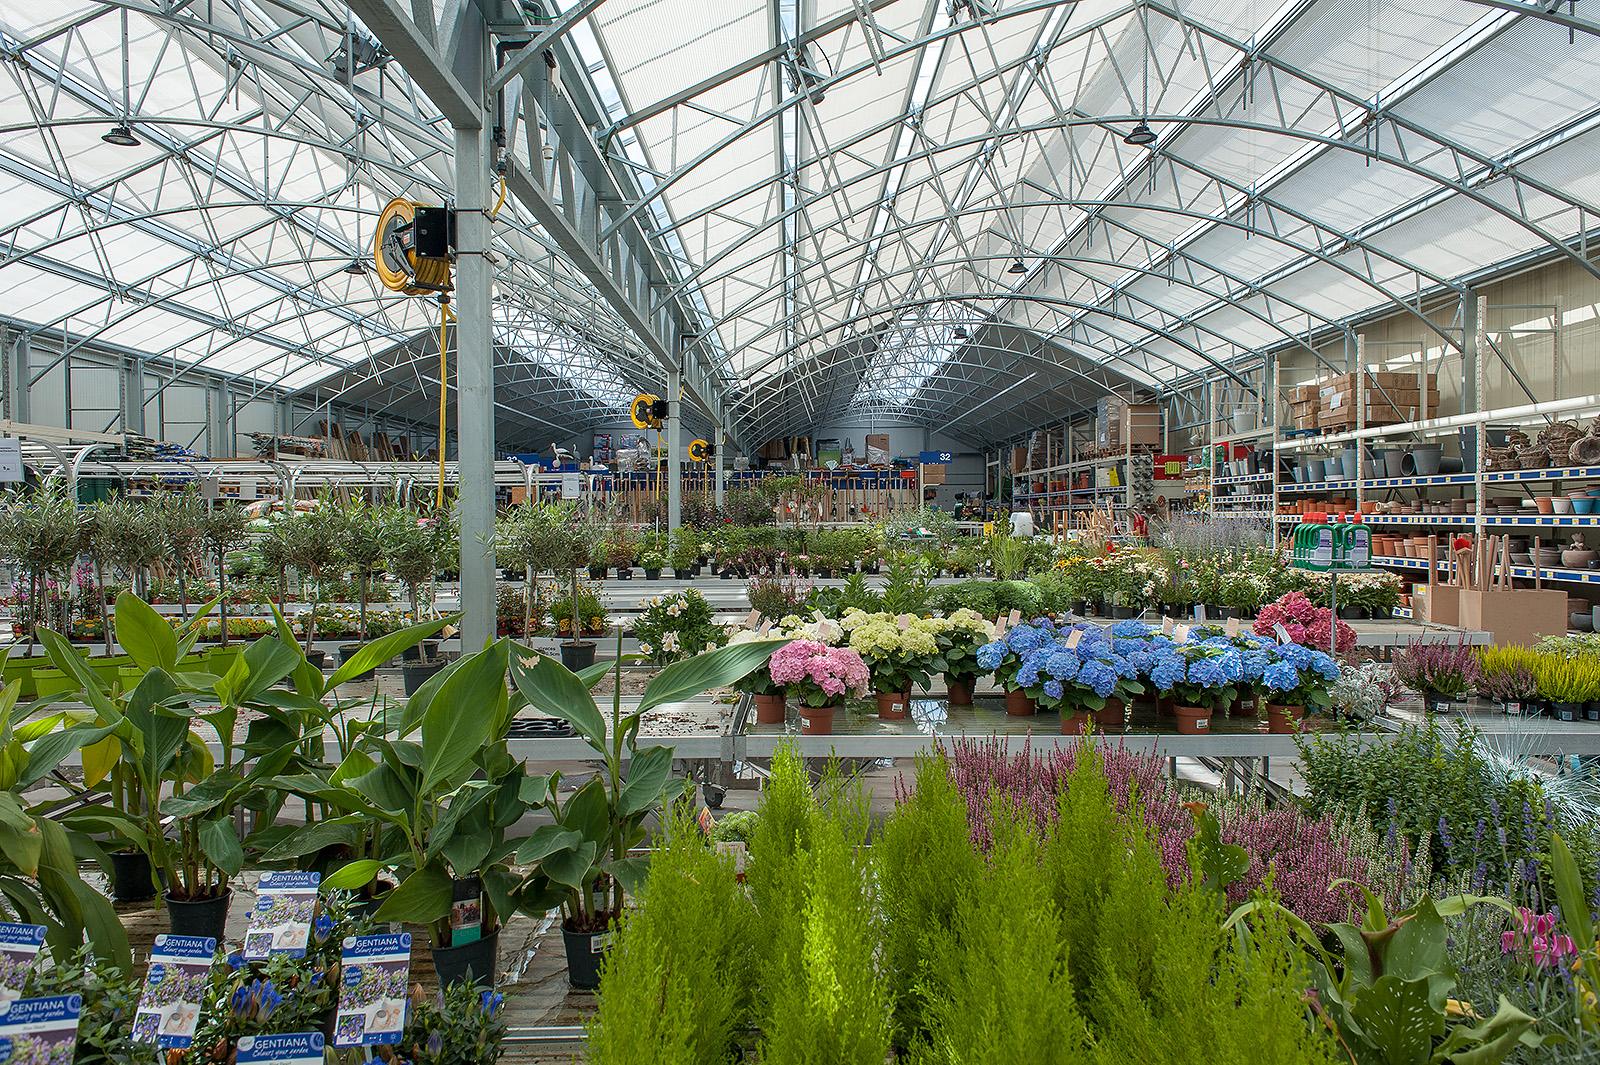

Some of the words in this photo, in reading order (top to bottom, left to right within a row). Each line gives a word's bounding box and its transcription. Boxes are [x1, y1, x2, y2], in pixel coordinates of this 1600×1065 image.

[165, 939, 203, 948] GENTIANA
[356, 938, 398, 948] GENTIANA
[186, 948, 202, 956] garden
[381, 945, 399, 955] garden
[10, 1000, 65, 1013] GENTIANA
[41, 1010, 65, 1022] garden
[254, 1037, 308, 1050] GENTIANA
[252, 1048, 274, 1058] Colours
[271, 1048, 289, 1060] your
[286, 1046, 309, 1058] garden
